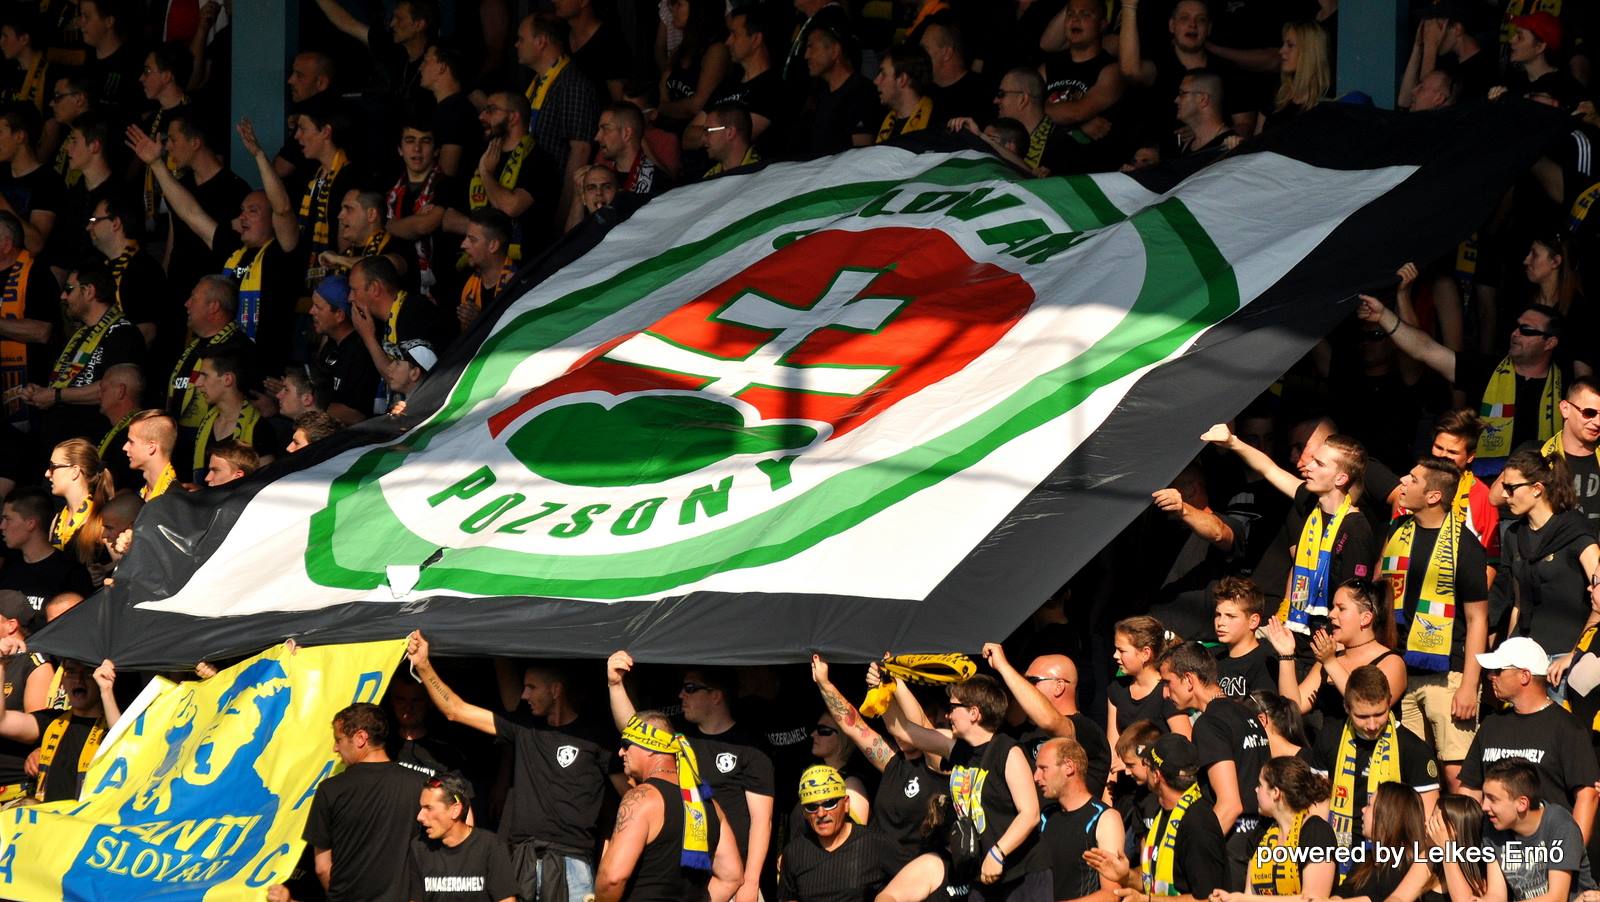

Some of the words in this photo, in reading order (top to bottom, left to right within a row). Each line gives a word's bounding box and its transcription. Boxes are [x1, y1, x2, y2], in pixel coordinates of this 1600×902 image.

[427, 455, 801, 538] POZSONY
[86, 836, 232, 883] SLOVAN
[110, 814, 263, 859] ANTI
